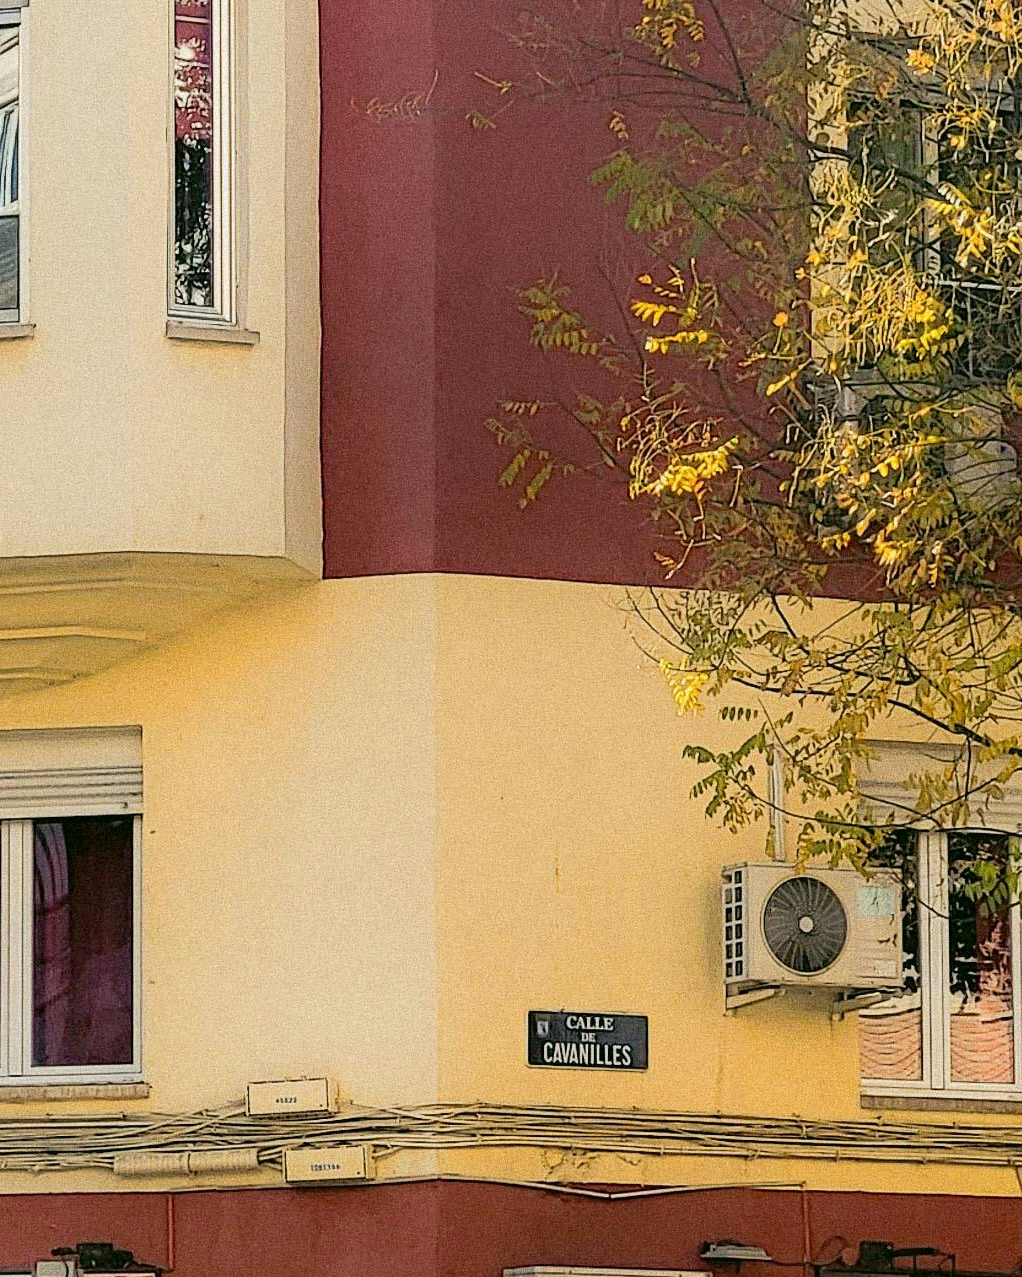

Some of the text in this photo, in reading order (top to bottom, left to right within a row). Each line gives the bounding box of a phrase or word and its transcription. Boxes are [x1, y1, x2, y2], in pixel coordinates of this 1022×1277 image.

[566, 1015, 614, 1031] CALLE
[581, 1032, 596, 1043] DE
[543, 1042, 632, 1066] CAVANILLES
